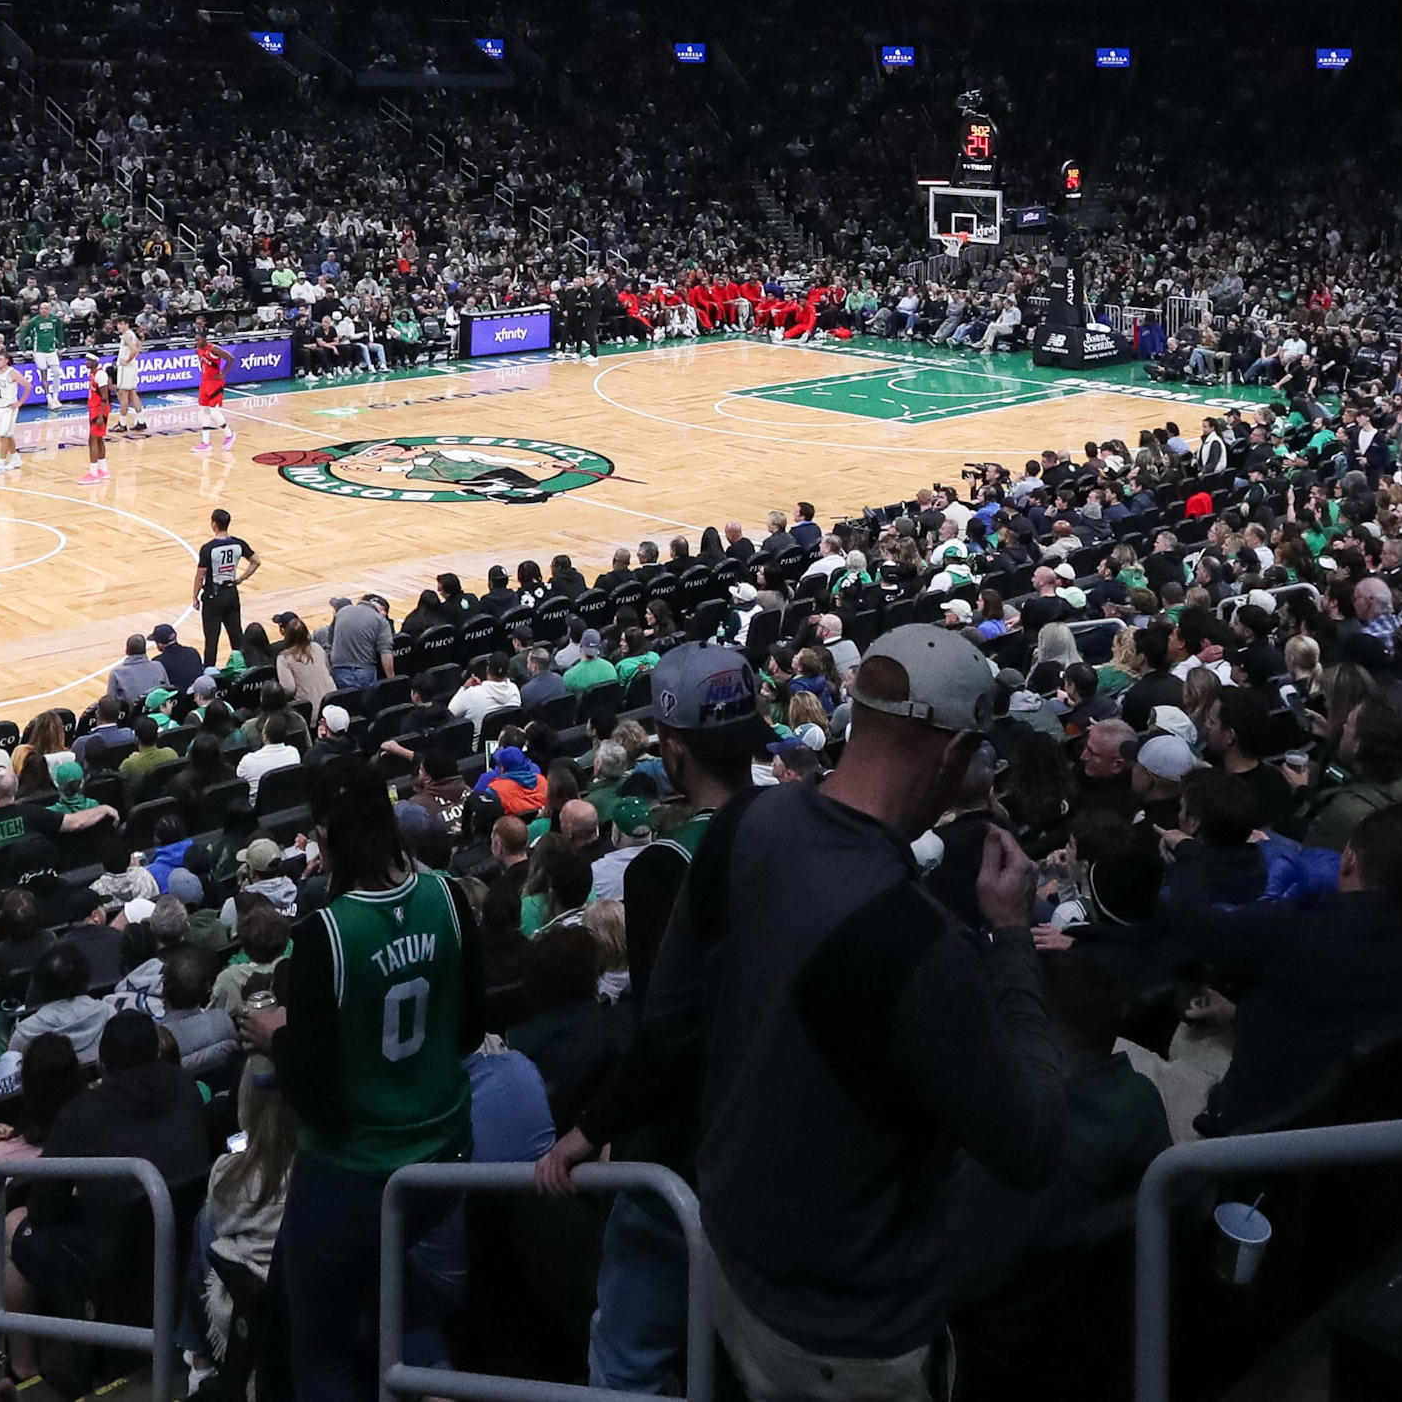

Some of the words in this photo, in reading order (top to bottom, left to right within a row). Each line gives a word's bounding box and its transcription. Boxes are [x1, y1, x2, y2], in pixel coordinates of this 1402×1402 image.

[966, 136, 989, 157] 24
[1067, 268, 1075, 306] xfinity
[493, 326, 529, 344] xfinity
[1083, 339, 1116, 353] Scientific
[240, 352, 282, 369] xfinity
[141, 374, 164, 384] PUMP
[165, 371, 193, 382] FAKES.
[1054, 378, 1202, 403] BOSTON
[434, 436, 599, 462] CELTICS
[288, 466, 435, 502] BOSTON
[220, 549, 234, 564] 78
[650, 585, 677, 596] PIMCO
[542, 608, 570, 621] PIMCO
[578, 601, 606, 614] PIMCO
[504, 617, 533, 631] PIMCO
[464, 627, 494, 641] PIMCO
[424, 637, 455, 650] PIMCO
[371, 933, 436, 977] TATUM
[382, 976, 430, 1062] 0
